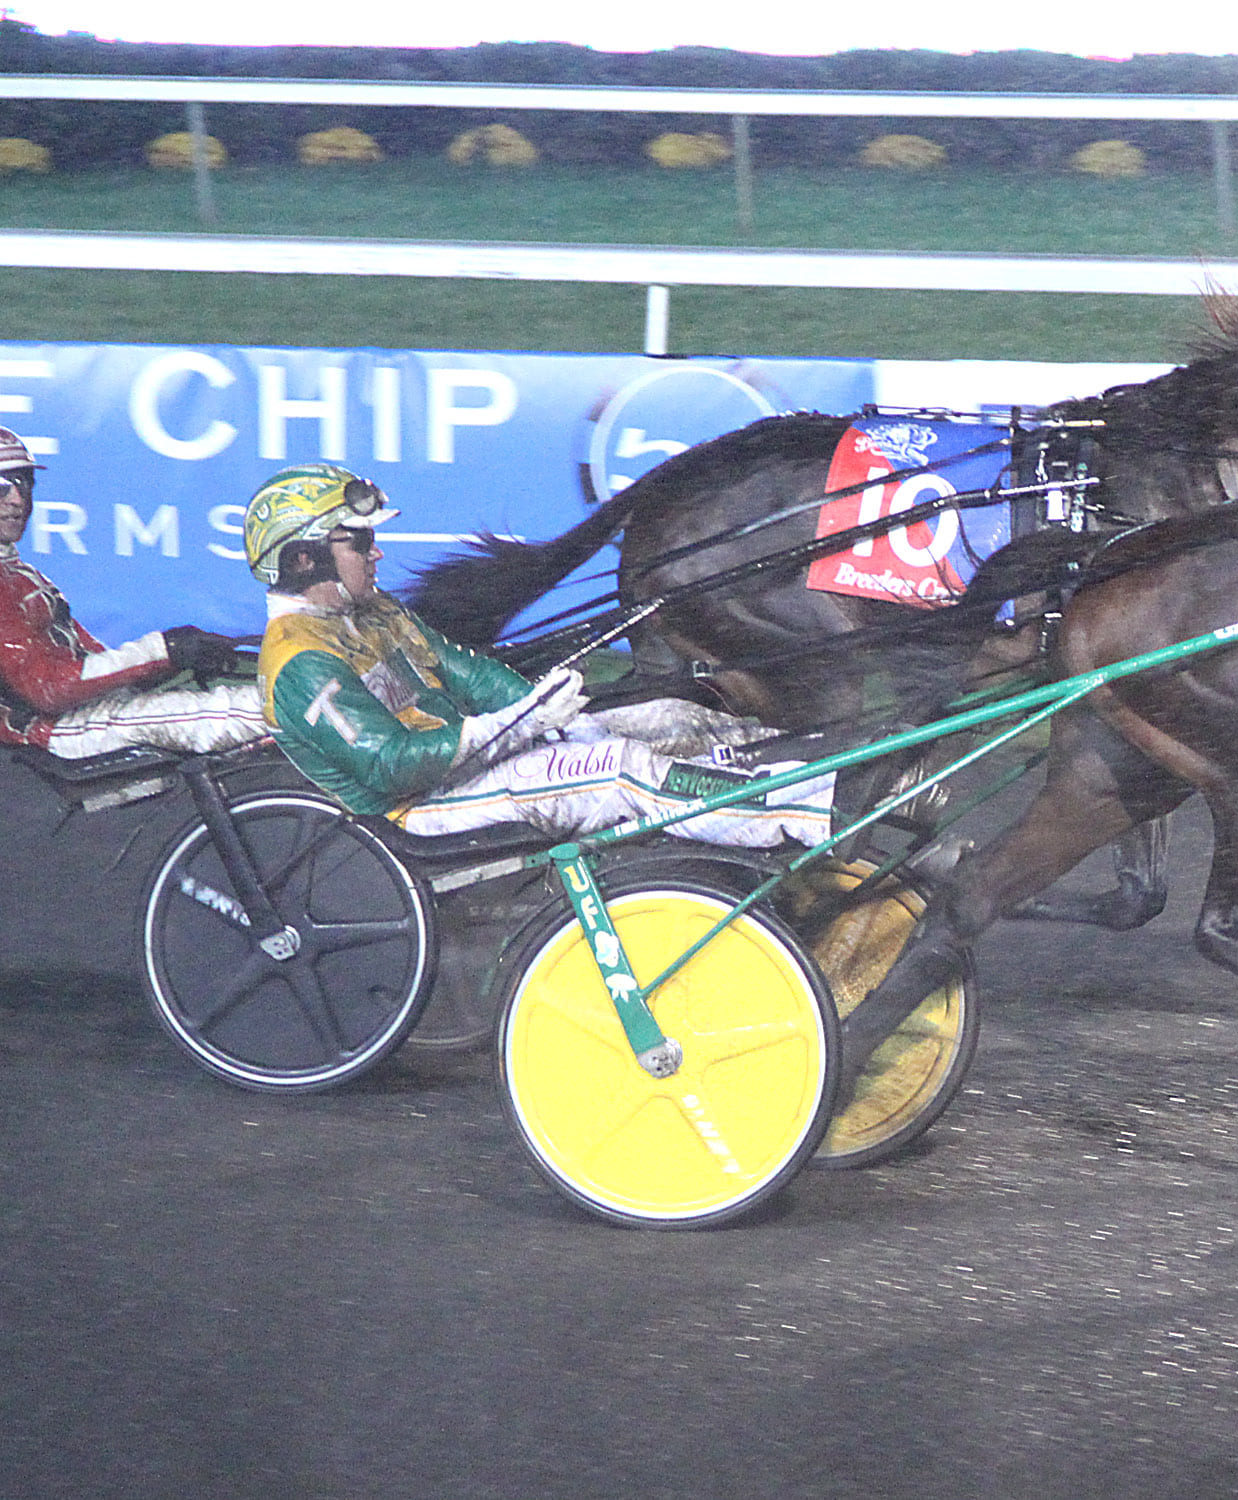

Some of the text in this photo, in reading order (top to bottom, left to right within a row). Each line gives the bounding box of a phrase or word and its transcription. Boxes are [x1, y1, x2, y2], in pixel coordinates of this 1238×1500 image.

[129, 351, 518, 463] CHIP
[852, 466, 960, 568] 10
[833, 562, 916, 597] Breeders
[513, 744, 619, 782] Walsh
